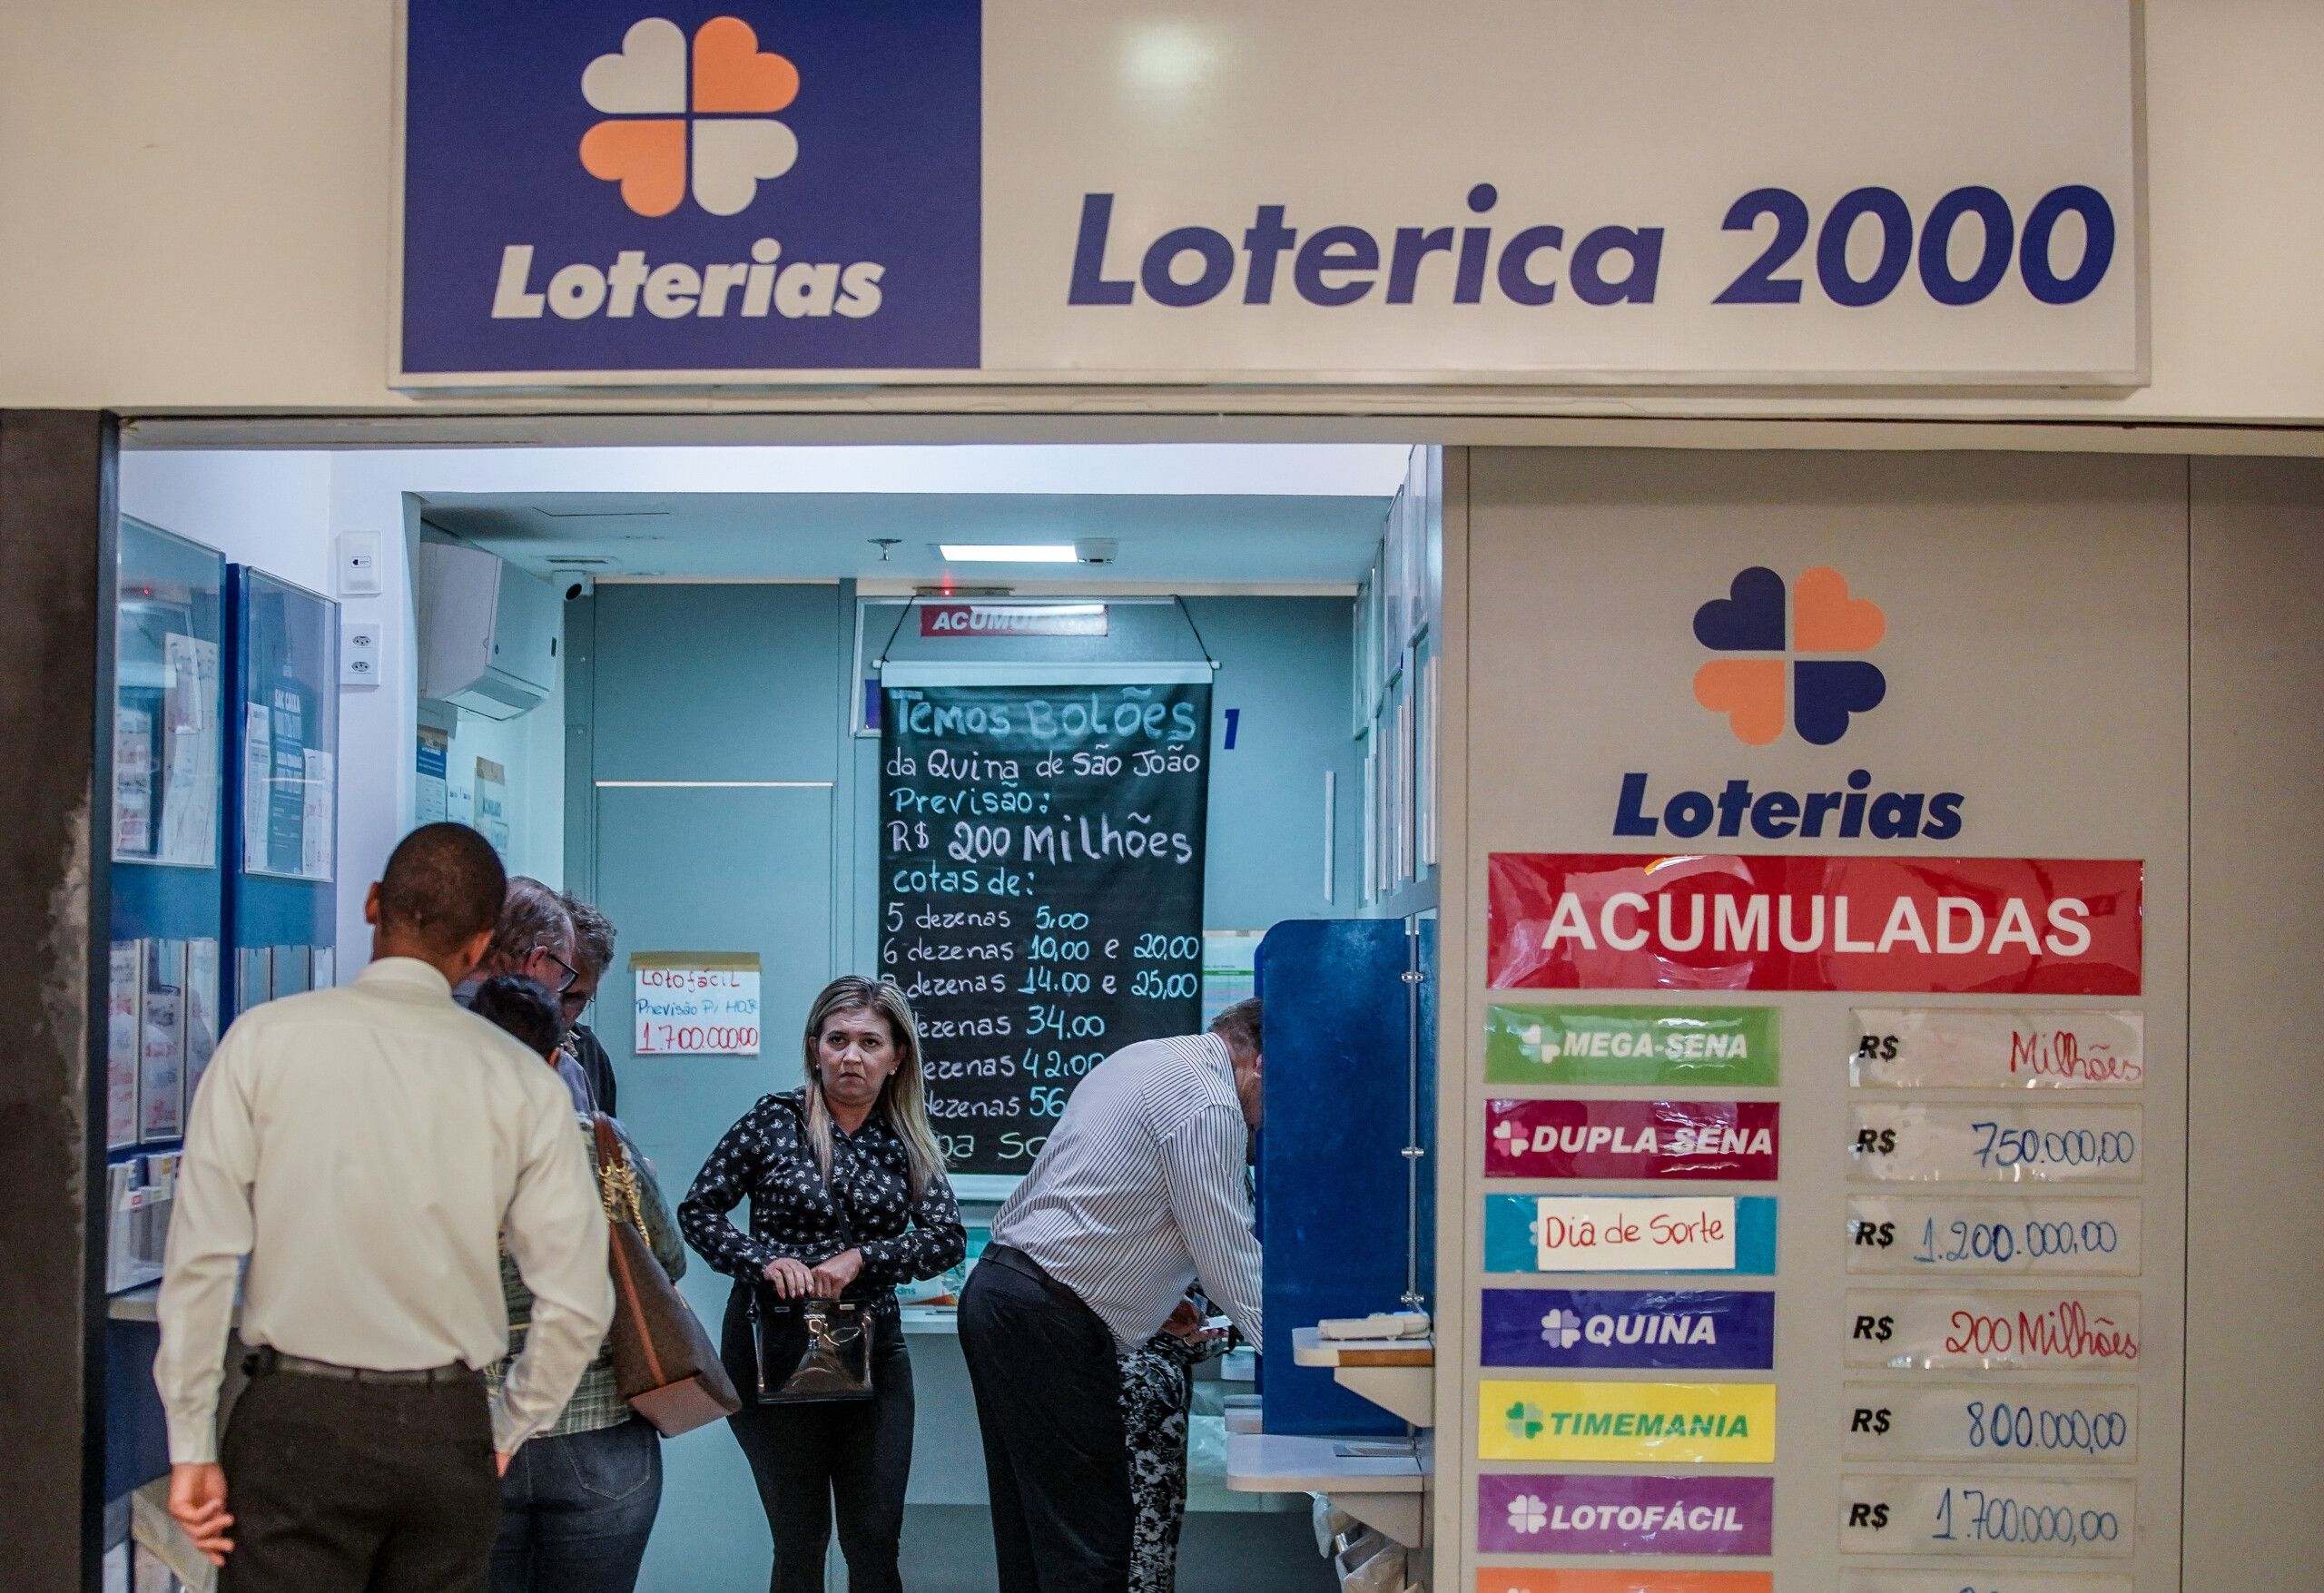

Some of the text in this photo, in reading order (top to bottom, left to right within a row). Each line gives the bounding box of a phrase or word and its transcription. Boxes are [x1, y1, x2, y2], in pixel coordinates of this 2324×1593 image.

[1068, 182, 2117, 308] Loterica 2000
[491, 237, 885, 320] Loterias
[889, 689, 1011, 738] Temos
[1224, 708, 1240, 751] 1
[886, 742, 1201, 782] da Quina de São João
[1612, 769, 1965, 841] Loterias
[887, 811, 1193, 866] R$ 200 Milhões
[887, 902, 905, 932] 5
[915, 903, 1011, 929] dezenas
[1541, 892, 2091, 957] ACUMULADAS
[883, 937, 898, 964] 6
[908, 937, 1014, 961] dezenas
[1104, 939, 1119, 959] e
[906, 970, 1007, 998] dezenas
[1101, 975, 1118, 994] e
[636, 998, 698, 1017] Previsão
[1563, 1032, 1748, 1059] MEGA-SENA
[1858, 1030, 2141, 1081] R$ Milhões
[923, 1055, 1015, 1080] ezenas
[1531, 1126, 1773, 1155] DUPLA SENA
[1856, 1122, 2133, 1168] R$ 750.000,00
[1546, 1211, 1724, 1248] Dia de Sorte
[1855, 1217, 2117, 1263] R$ 1.200.000,00
[1585, 1314, 1717, 1347] QUINA
[1853, 1301, 2138, 1359] R$ 200 Milhões
[1551, 1412, 1748, 1438] TIMEMANIA
[1850, 1401, 2126, 1454] R$ 800.000,00
[1551, 1500, 1743, 1531] LOTOFÁCIL
[1848, 1502, 1890, 1531] R$
